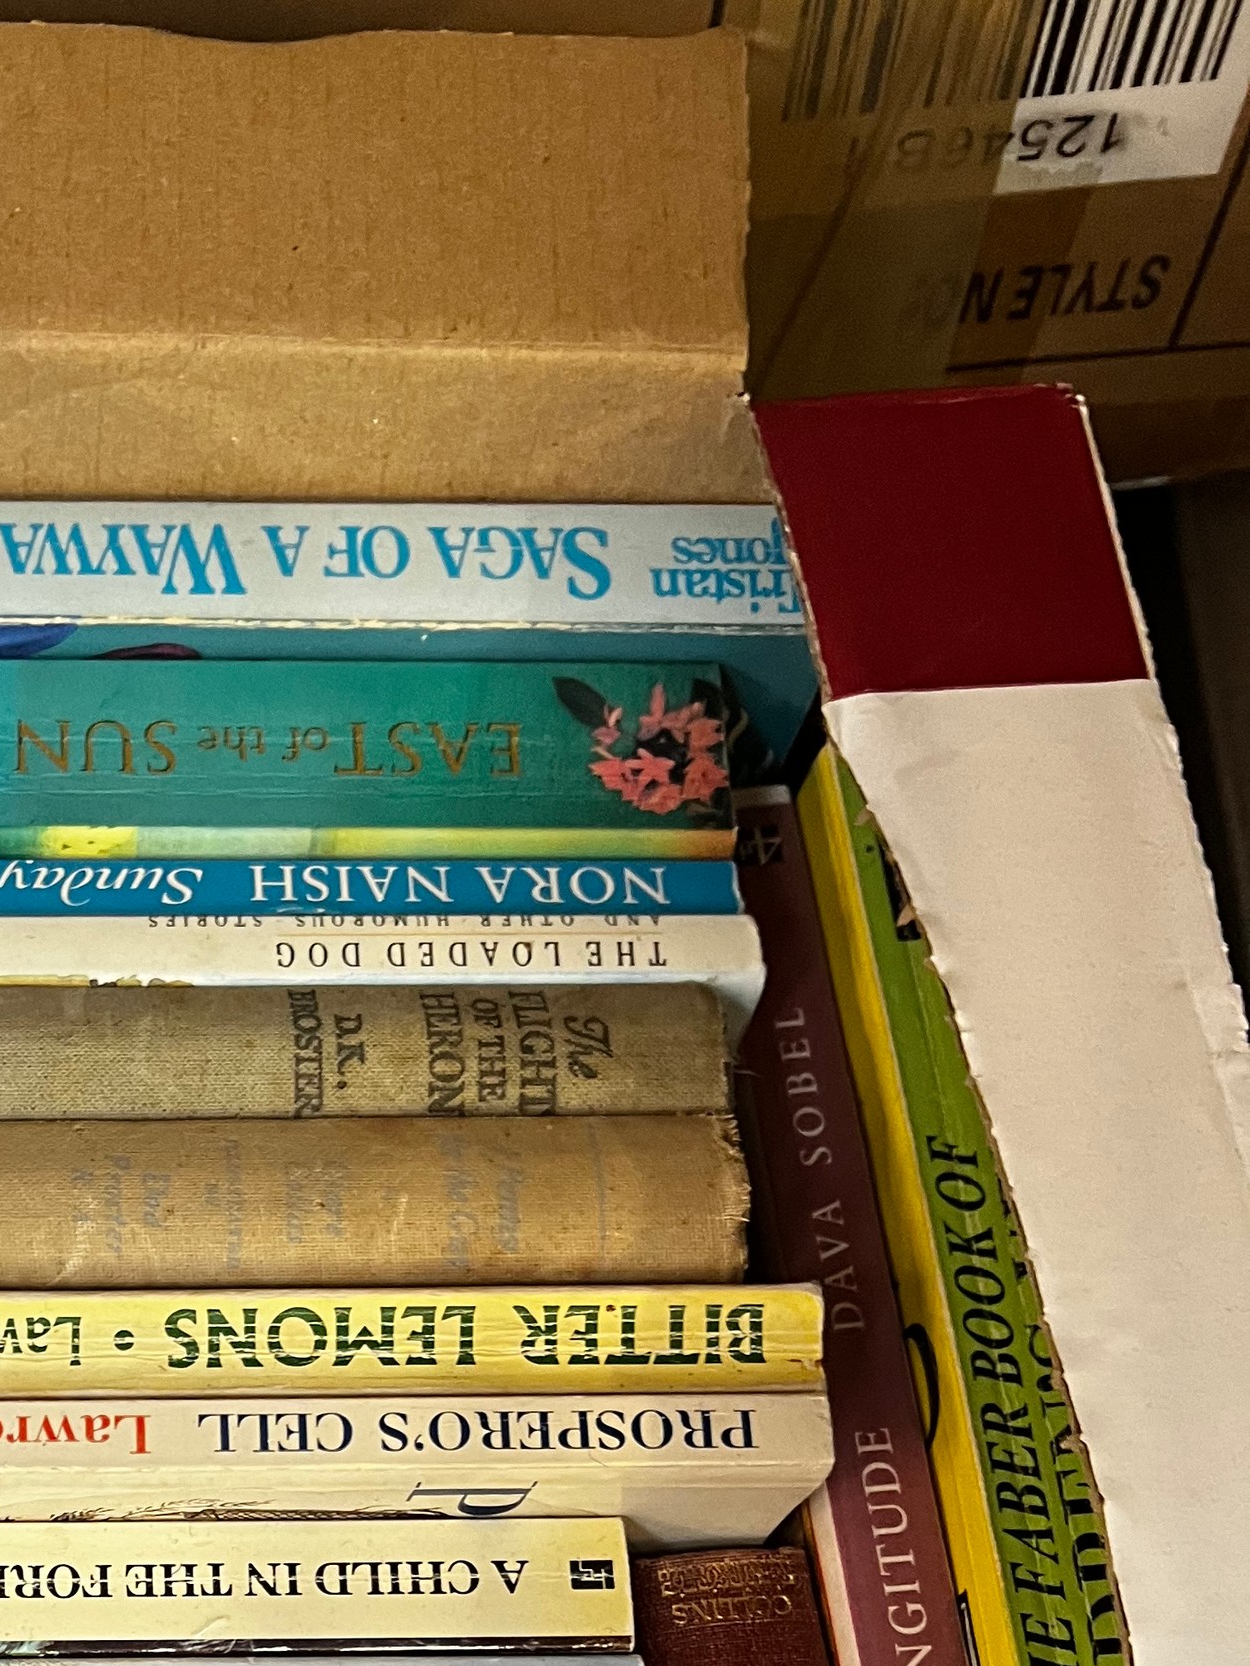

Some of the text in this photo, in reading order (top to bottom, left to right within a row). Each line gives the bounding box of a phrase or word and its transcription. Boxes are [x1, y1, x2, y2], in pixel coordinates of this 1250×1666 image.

[1008, 254, 1172, 321] STYLE
[263, 525, 311, 581] A
[325, 523, 410, 580] OF
[428, 523, 613, 601] SAGA
[12, 718, 525, 778] EAST of the SUN
[248, 864, 450, 906] NAISH
[472, 864, 670, 906] NORA
[147, 914, 263, 928] STORIES
[275, 941, 667, 969] THE LOADED DOG
[417, 988, 466, 1118] HERON
[470, 1000, 507, 1102] OF THE
[507, 988, 558, 1118] FLIGHT
[562, 1016, 616, 1080] The
[768, 1005, 866, 1335] DAVA SOBEL
[923, 1132, 990, 1215] OF
[939, 1222, 1028, 1388] BOOK
[164, 1301, 477, 1369] LEMONS
[506, 1301, 768, 1369] BITTER
[197, 1409, 354, 1456] CELL
[378, 1406, 759, 1457] PROSPERO'S
[976, 1404, 1074, 1600] FABER
[125, 1558, 236, 1598] THE
[248, 1558, 302, 1597] IN
[315, 1557, 482, 1597] CHILD
[489, 1557, 530, 1597] A
[671, 1594, 793, 1626] COLLINS
